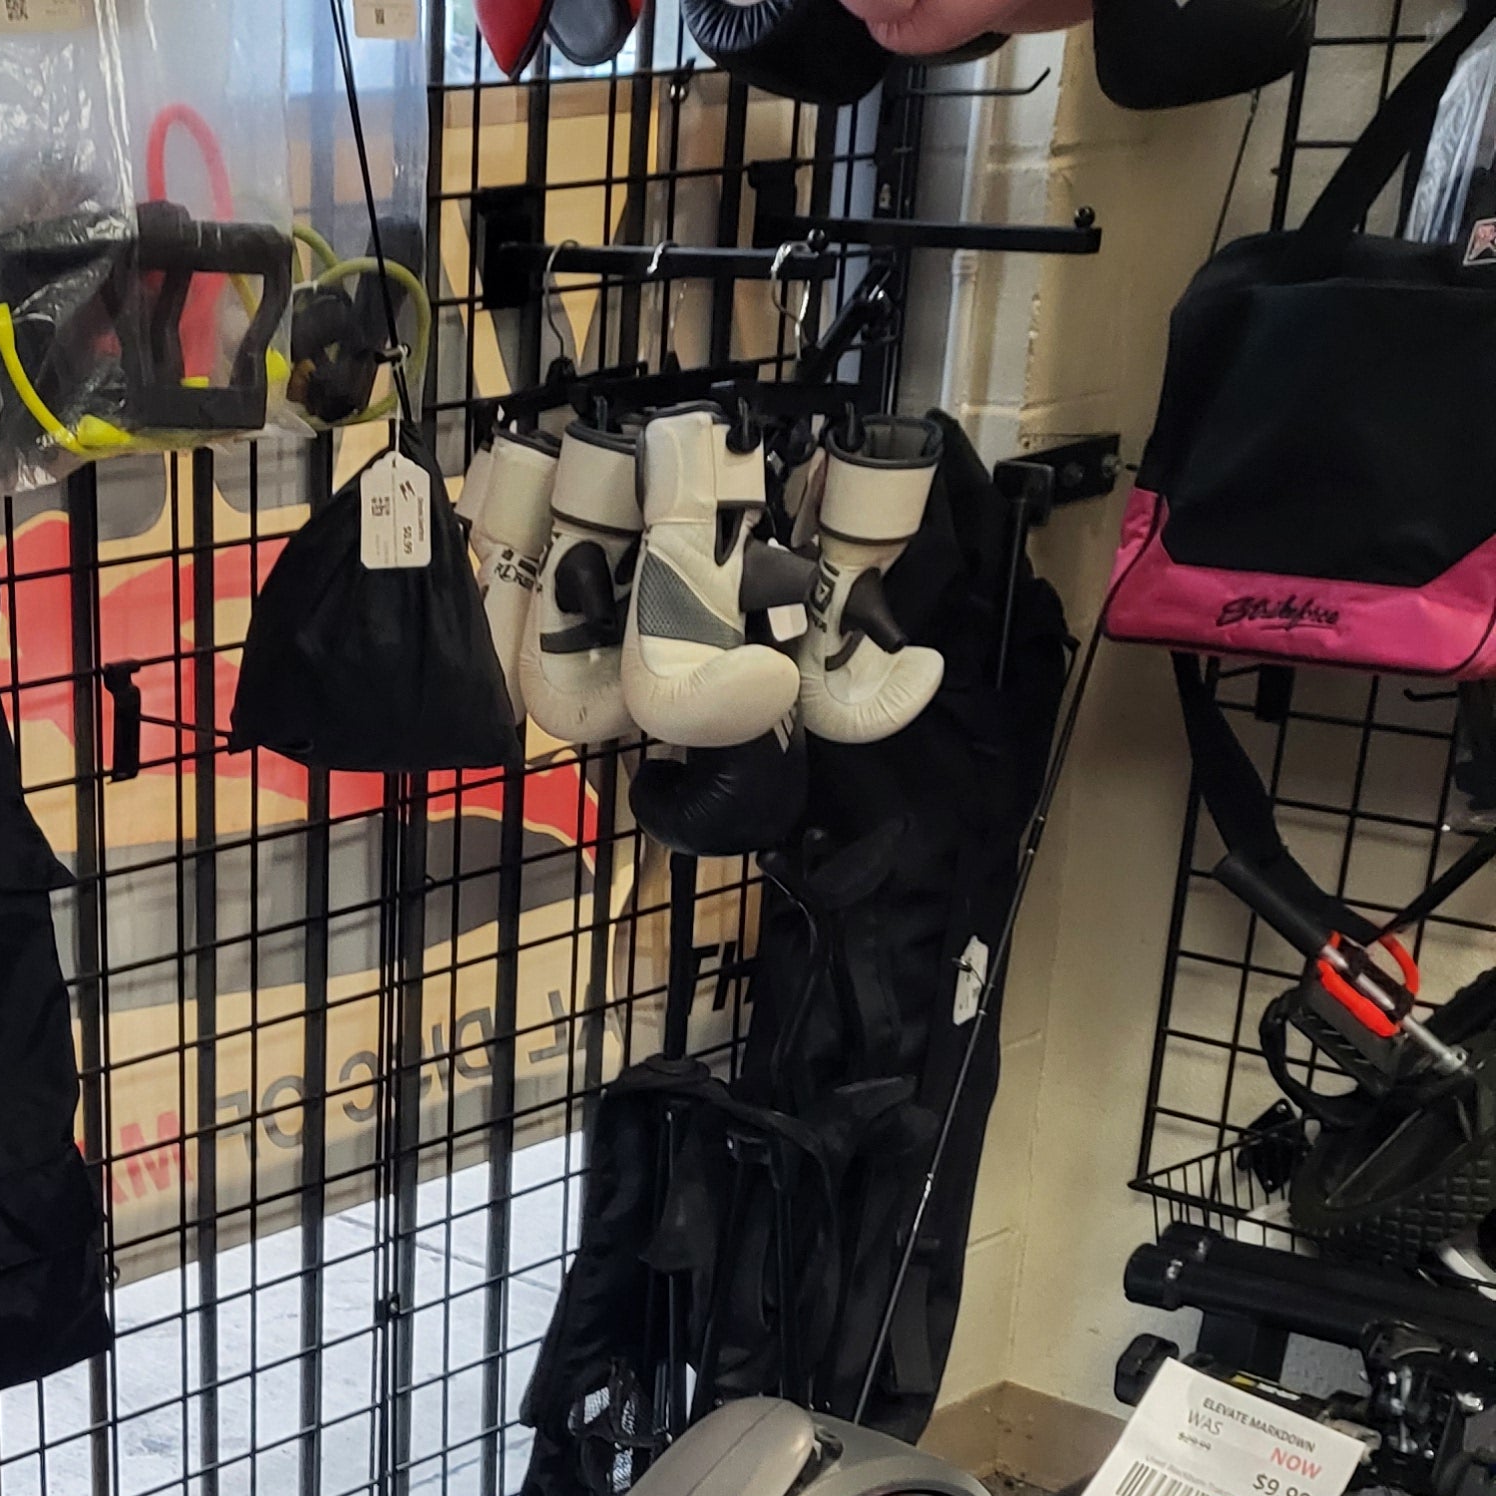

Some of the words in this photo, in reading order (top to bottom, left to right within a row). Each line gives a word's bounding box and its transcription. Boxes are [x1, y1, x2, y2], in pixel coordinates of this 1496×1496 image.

[1187, 1409, 1223, 1435] WAS
[1203, 1397, 1248, 1425] ELEVATE
[1248, 1416, 1315, 1453] MARKDOWN
[1271, 1446, 1321, 1480] NOW
